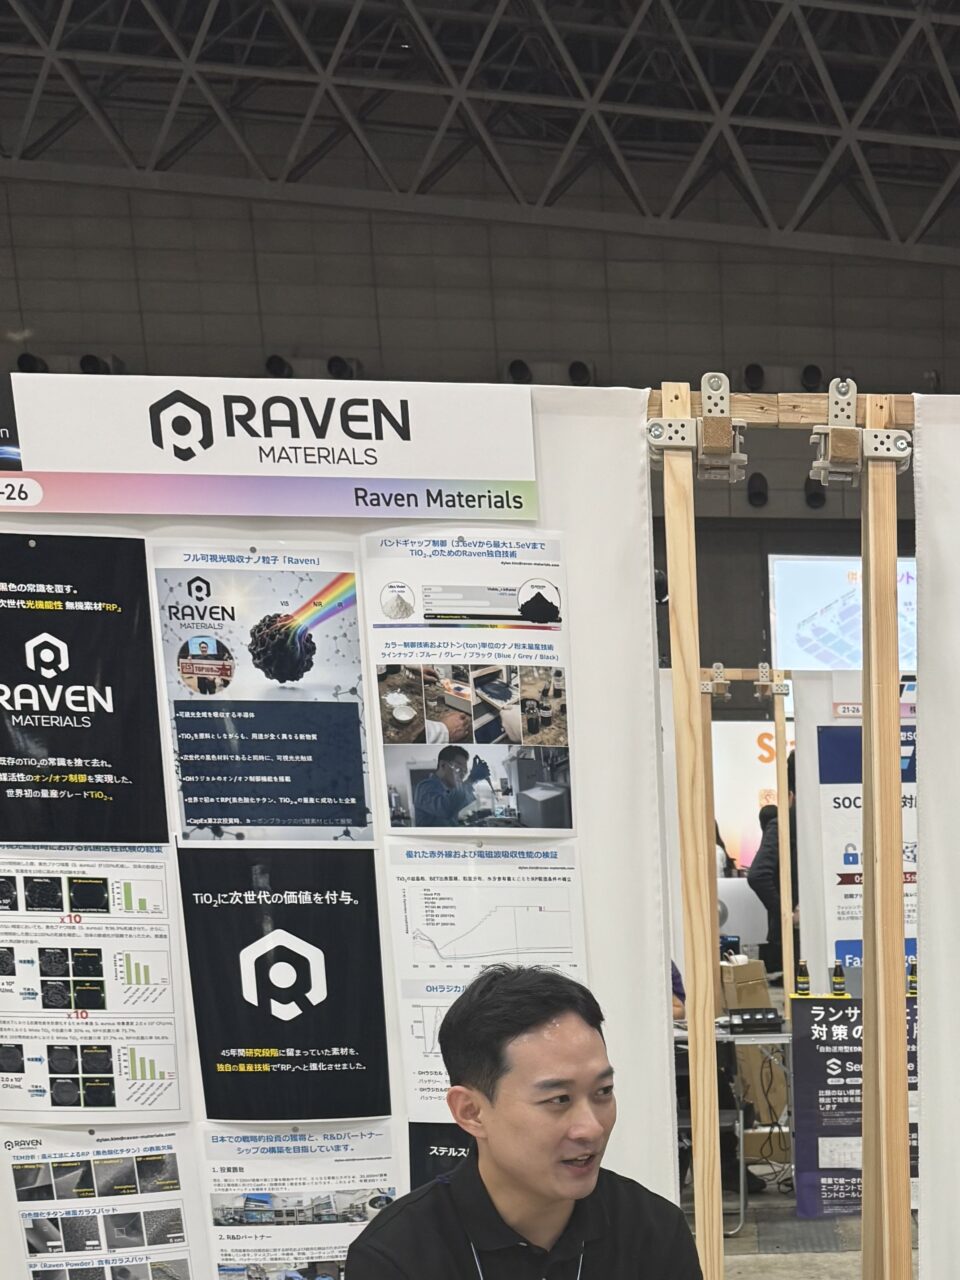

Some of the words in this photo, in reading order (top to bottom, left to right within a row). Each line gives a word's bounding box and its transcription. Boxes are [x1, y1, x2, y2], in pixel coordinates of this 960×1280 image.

[222, 394, 412, 442] RAVEN
[258, 445, 378, 465] MATERIALS
[353, 487, 419, 508] Raven
[426, 488, 523, 510] Materials
[183, 553, 321, 566] フル可視光吸収ナノ粒子「Raven」
[168, 605, 236, 621] RAVEN
[179, 622, 224, 630] MATERIALS
[0, 683, 114, 713] RAVEN
[11, 715, 92, 728] MATERIALS
[405, 850, 558, 859] 優れた赤外線および電磁波吸収性能の検証
[810, 1006, 862, 1022] ランサ
[13, 1138, 42, 1147] RAVEN
[429, 1146, 470, 1158] ステルス
